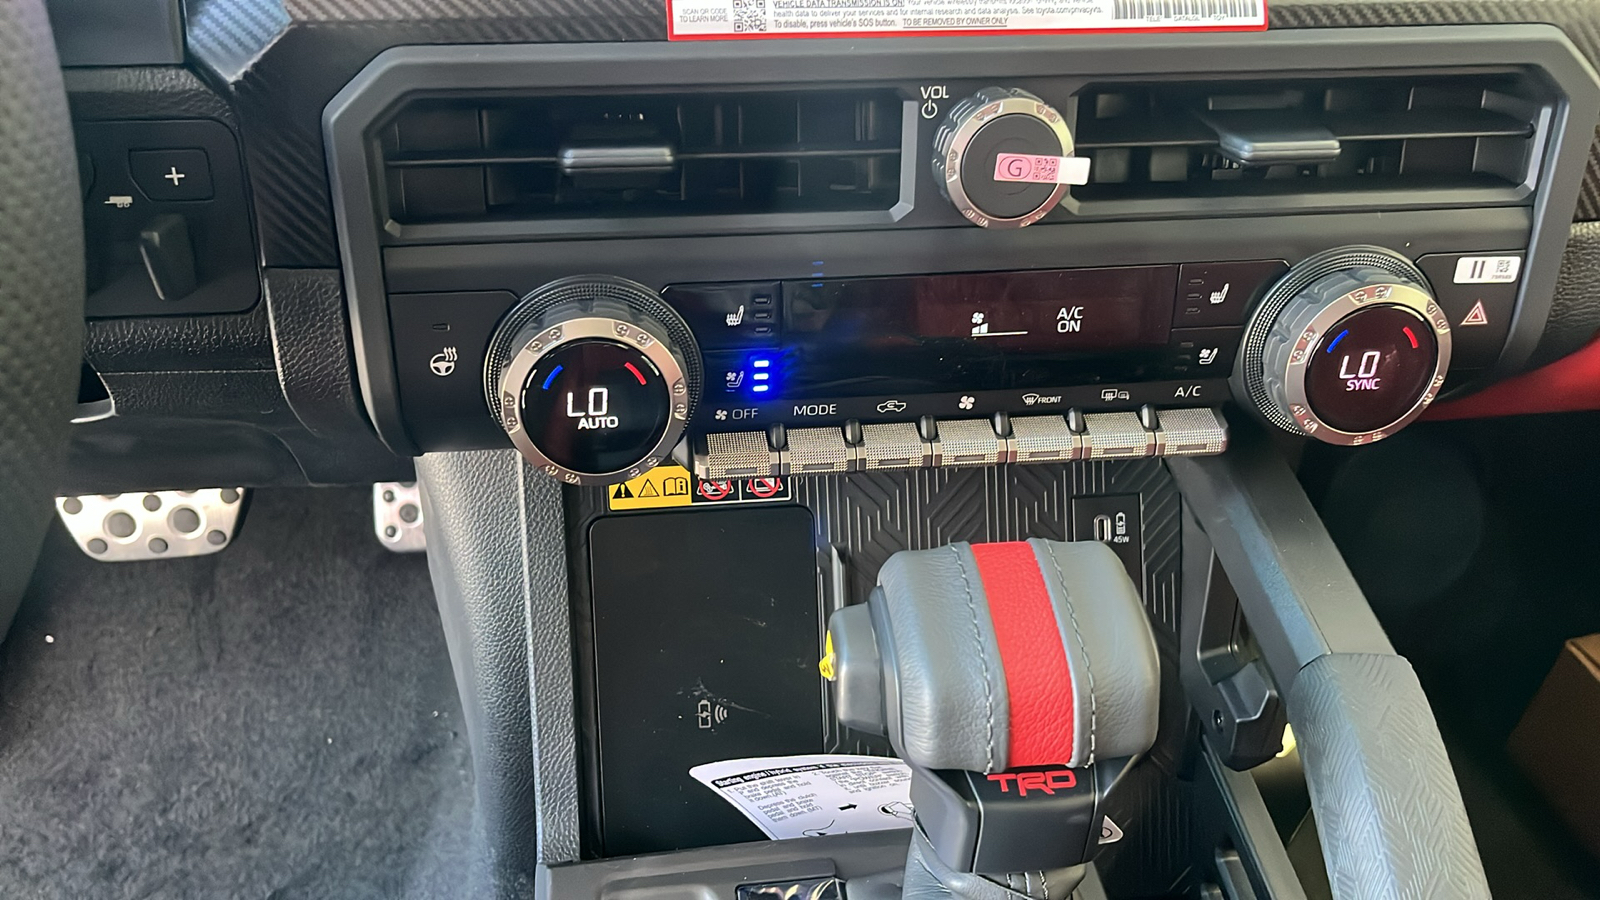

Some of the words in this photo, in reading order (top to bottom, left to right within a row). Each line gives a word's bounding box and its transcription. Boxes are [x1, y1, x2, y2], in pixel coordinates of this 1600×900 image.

[773, 0, 804, 8] VEHICLE
[806, 0, 826, 8] DATA
[828, 0, 882, 8] TRANSMISSION
[842, 10, 856, 20] your
[1022, 6, 1034, 14] See
[774, 20, 782, 28] To
[783, 19, 808, 28] disable,
[810, 20, 827, 29] press
[829, 18, 857, 27] vehicle's
[858, 18, 874, 27] SOS
[875, 18, 897, 27] button.
[903, 18, 911, 26] TO
[923, 17, 955, 25] REMOVED
[956, 17, 965, 25] BY
[966, 17, 990, 25] OWNER
[991, 17, 1009, 25] ONLY
[920, 85, 949, 99] VOL
[1007, 159, 1024, 178] G
[1056, 306, 1084, 320] A/C
[1057, 320, 1081, 333] ON
[1346, 378, 1381, 391] SYNC
[1174, 385, 1202, 398] A/C
[1038, 395, 1062, 404] FRONT
[732, 408, 759, 420] OFF
[793, 403, 838, 416] MODE
[578, 416, 619, 430] AUTO
[1113, 535, 1130, 543] 45W
[715, 776, 745, 787] Starting
[743, 772, 767, 780] engine
[987, 770, 1077, 796] TRD
